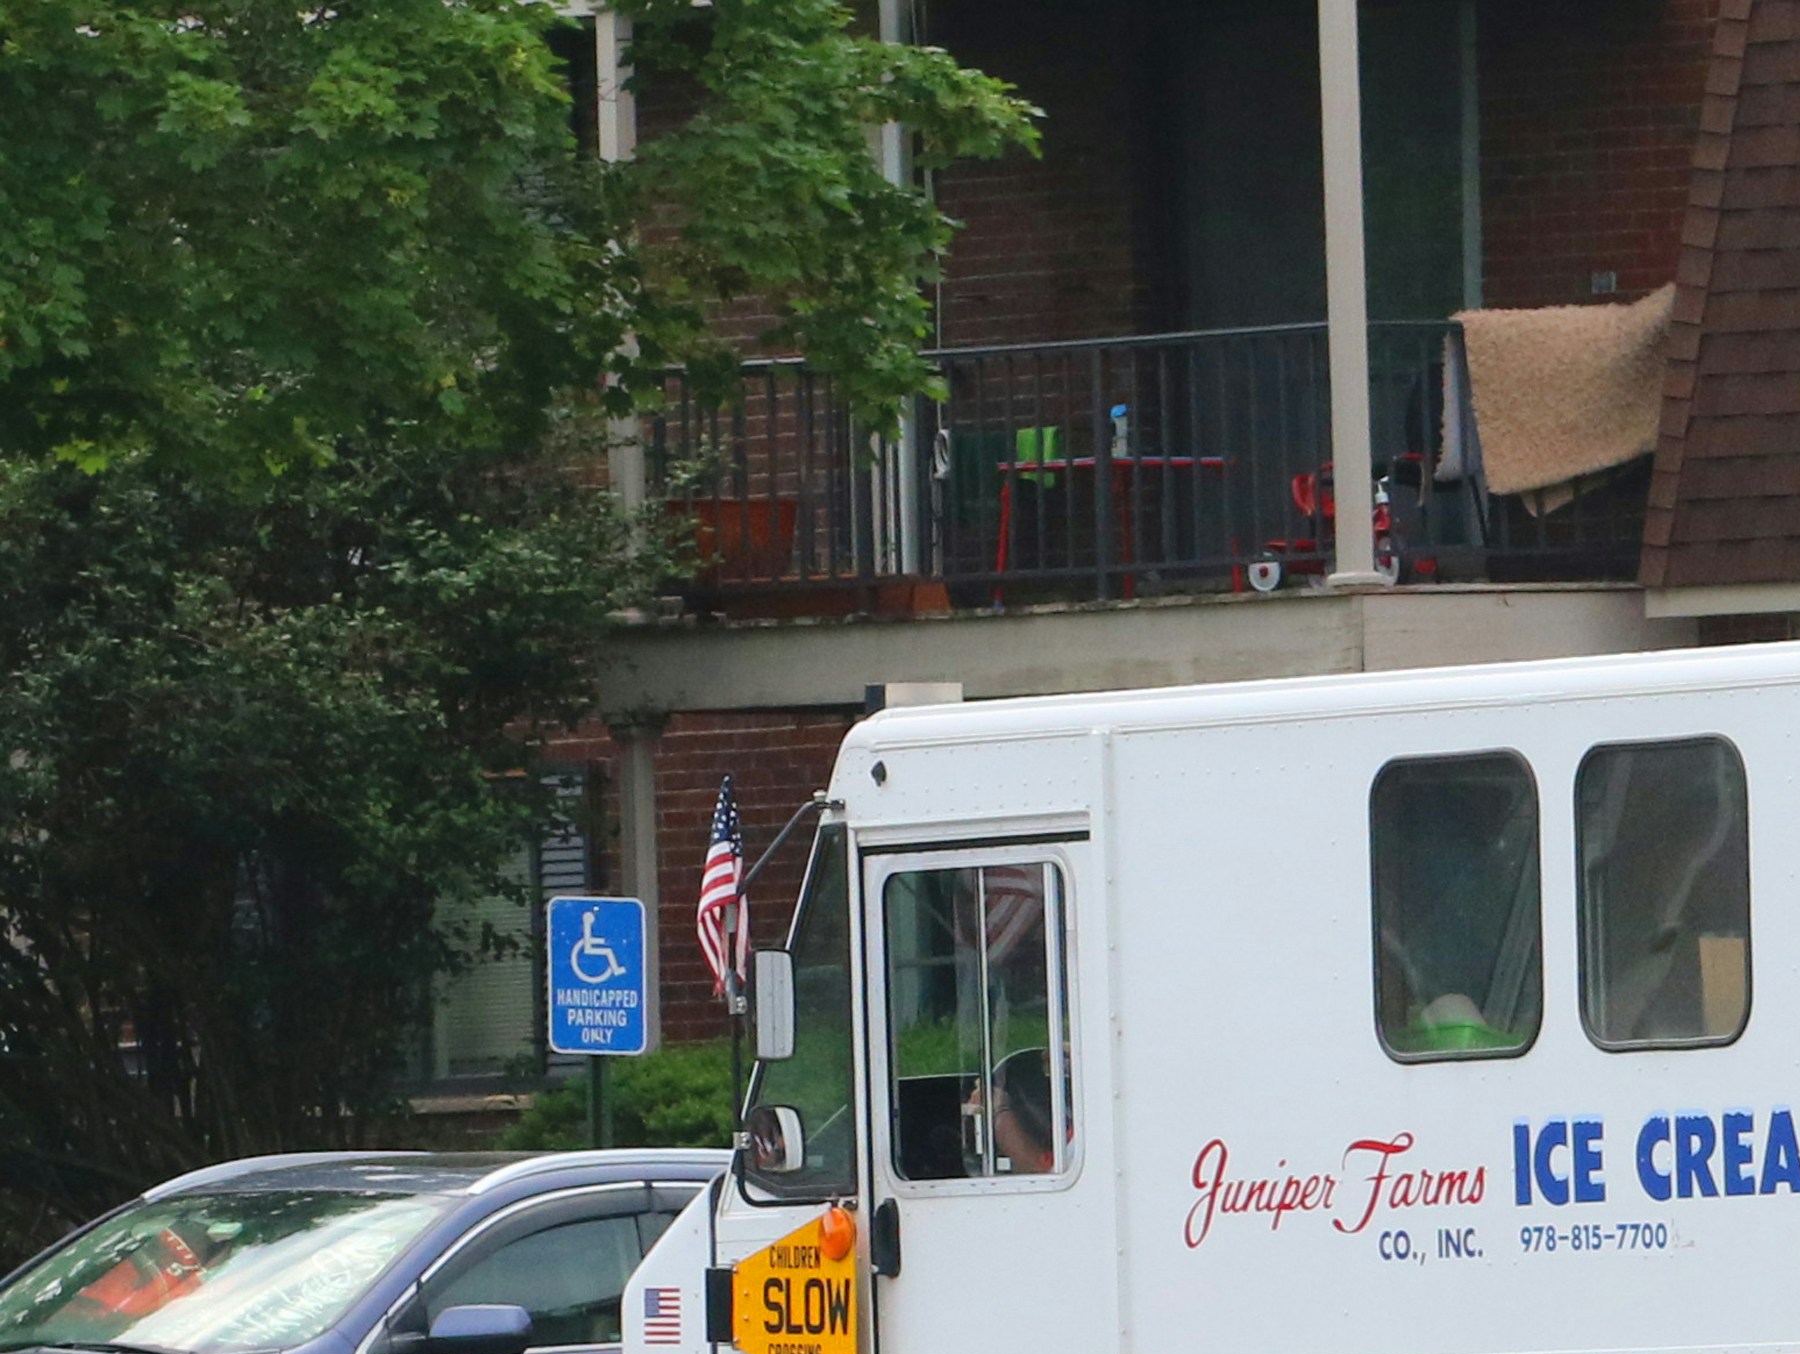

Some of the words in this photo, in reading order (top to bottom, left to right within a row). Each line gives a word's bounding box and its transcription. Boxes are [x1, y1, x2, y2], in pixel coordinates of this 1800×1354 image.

[556, 988, 639, 1009] HANDICAPPED
[567, 1008, 628, 1027] PARKING
[581, 1027, 614, 1044] ONLY
[1183, 1138, 1338, 1250] Juniper
[1332, 1131, 1487, 1234] Farms
[1512, 1114, 1607, 1207] ICE
[1378, 1230, 1426, 1266] CO.,
[1437, 1228, 1484, 1259] INC.
[1519, 1222, 1668, 1253] 978-815-7700
[768, 1246, 822, 1269] CHILDREN
[762, 1277, 851, 1336] SLOW
